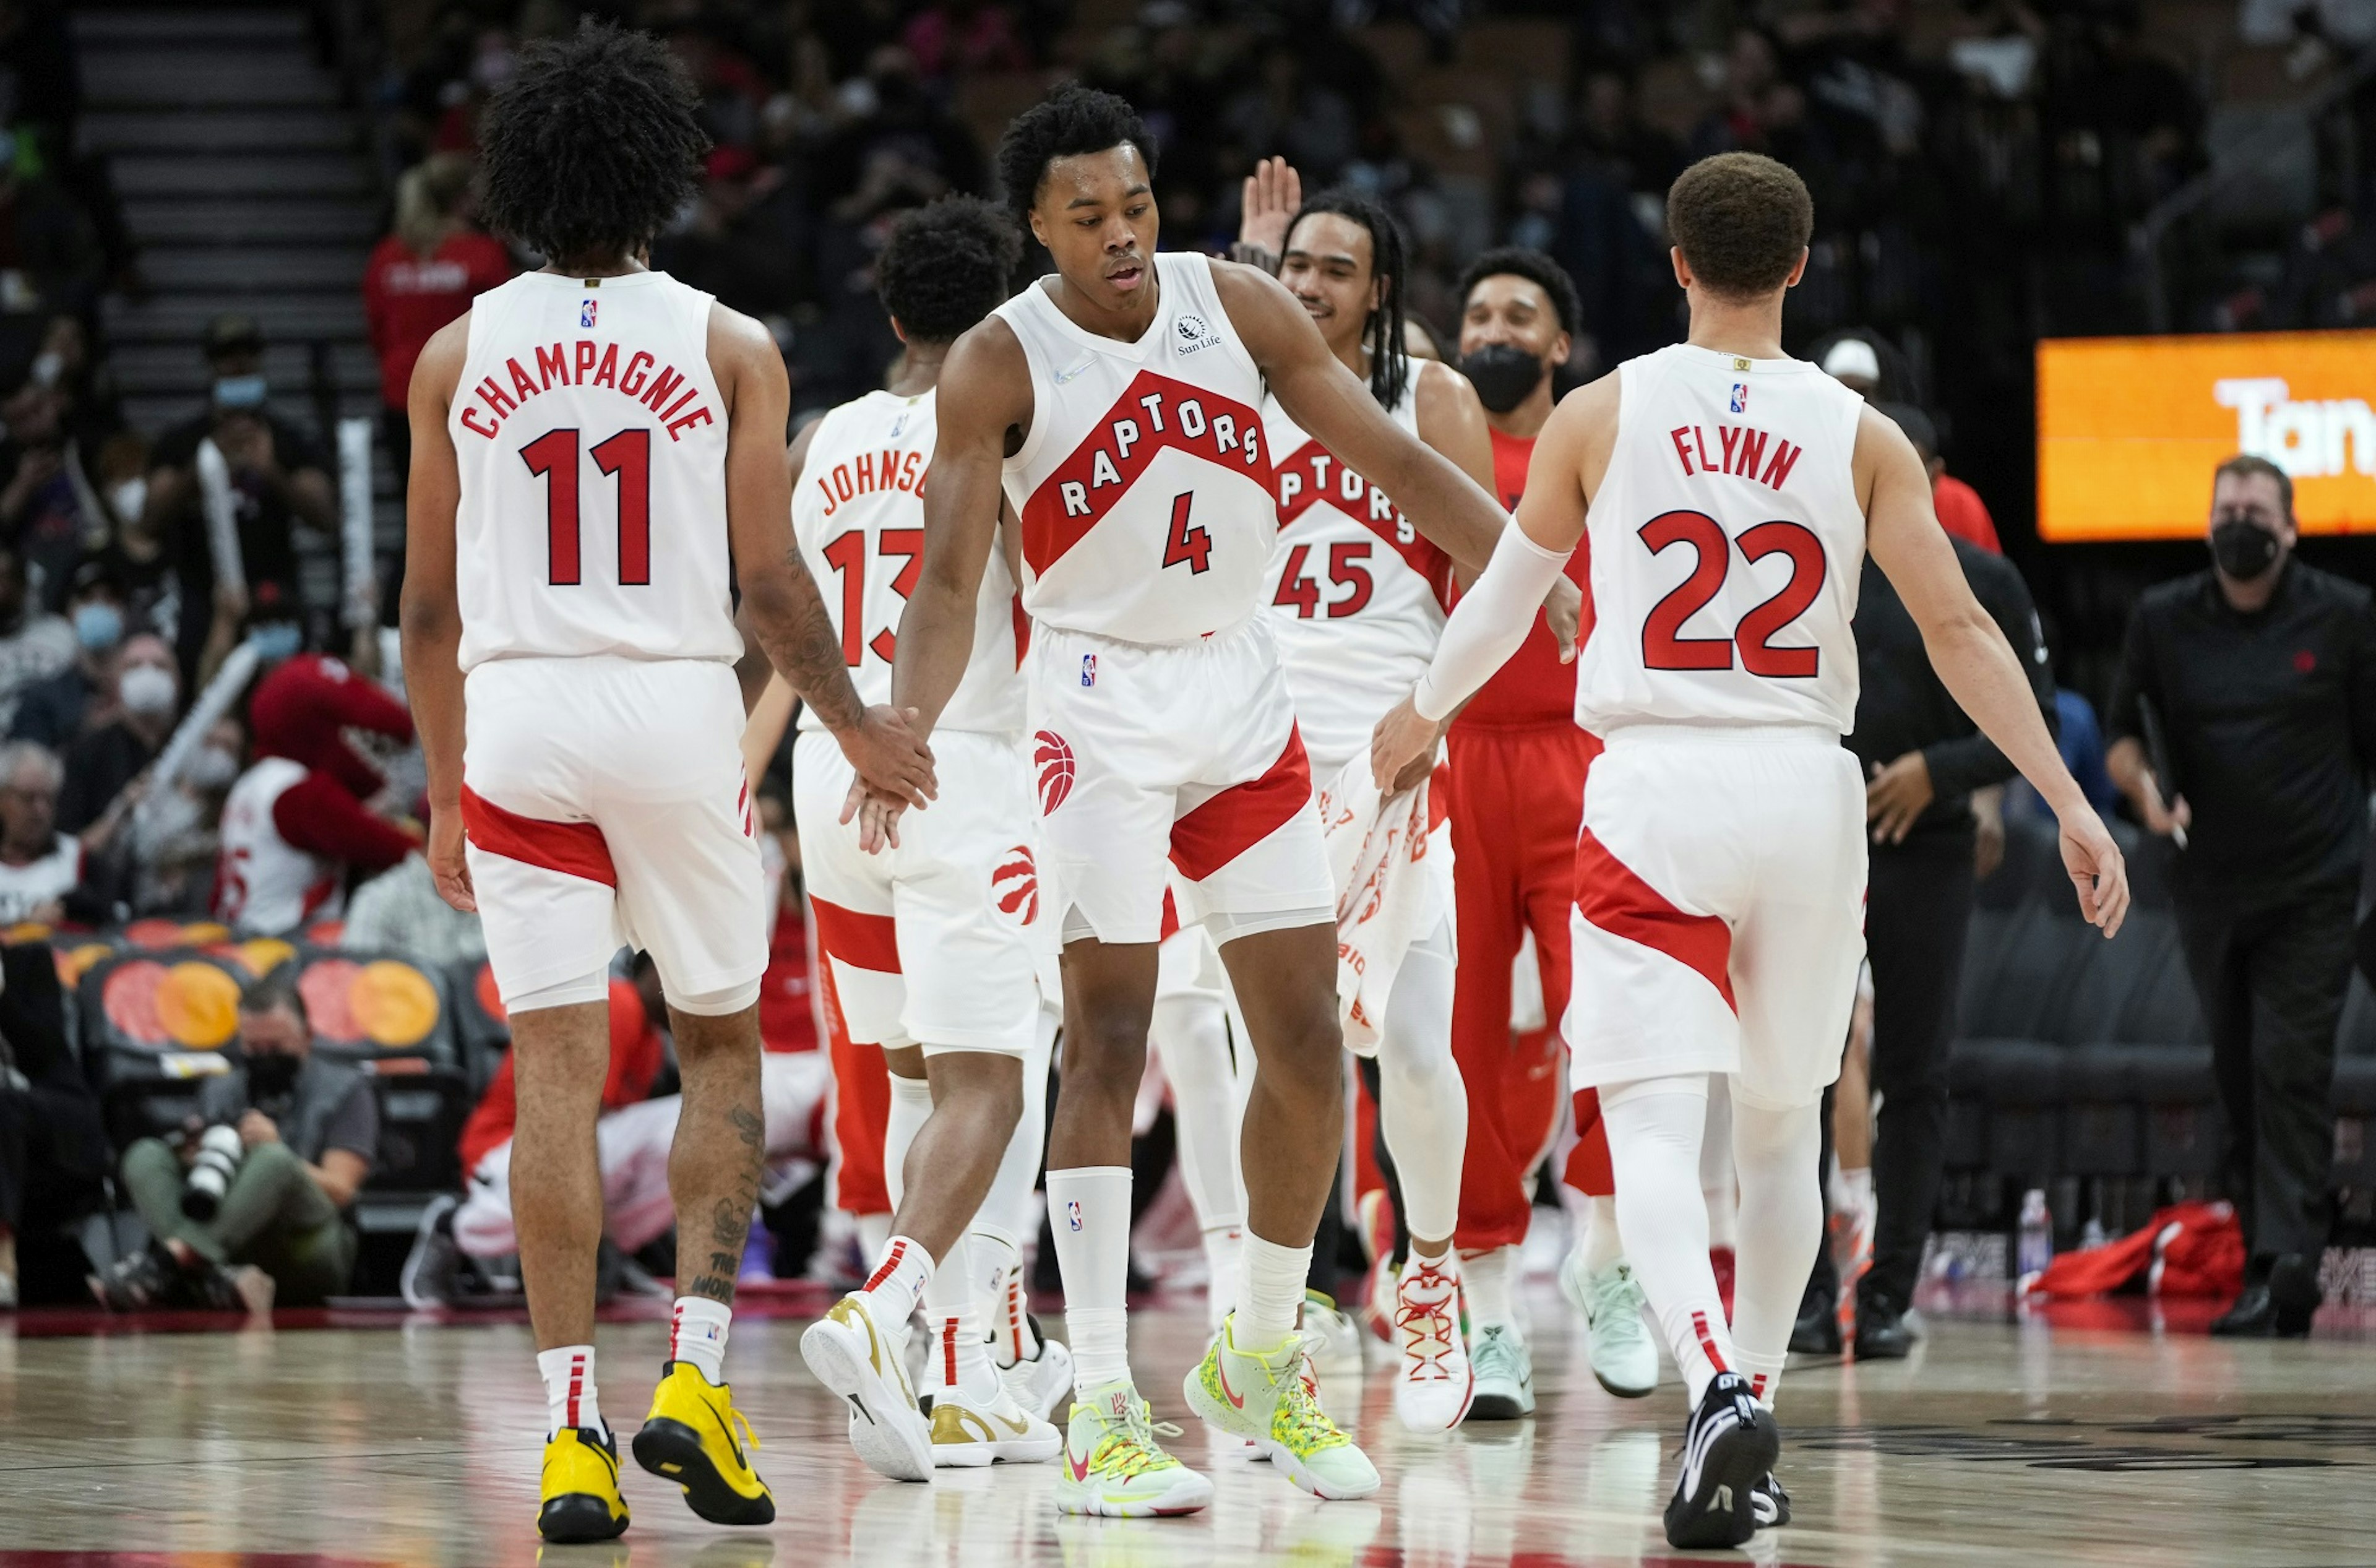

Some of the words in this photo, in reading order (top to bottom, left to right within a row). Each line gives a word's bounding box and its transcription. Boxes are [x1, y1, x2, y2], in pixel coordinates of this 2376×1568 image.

[1177, 343, 1200, 356] Sun
[1201, 335, 1221, 349] Life
[460, 340, 714, 442] CHAMPAGNIE
[817, 450, 928, 516] JOHNS
[1059, 392, 1258, 517] RAPTORS
[1671, 425, 1802, 491] FLYNN
[518, 428, 650, 585] 11
[1161, 490, 1212, 575] 4
[1272, 541, 1374, 619] 45
[1637, 509, 1827, 678] 22
